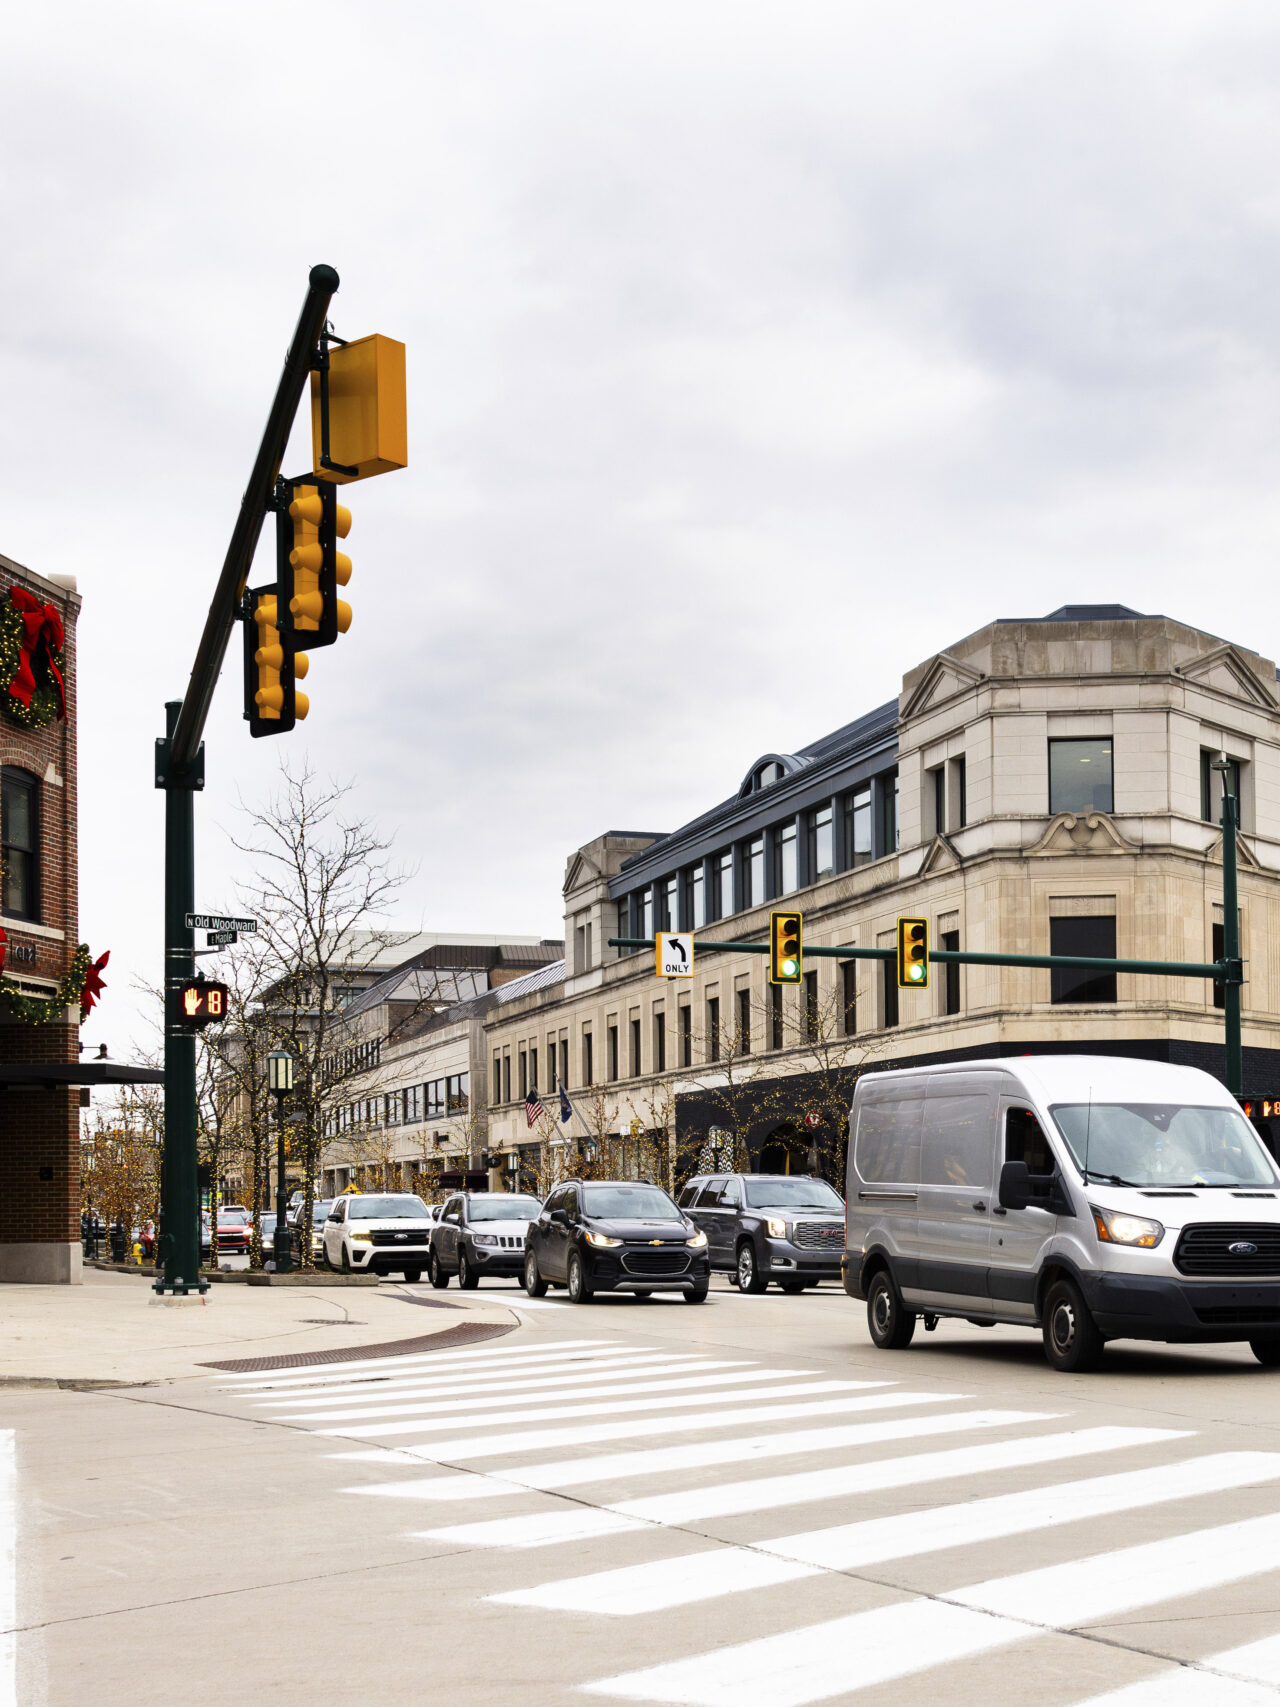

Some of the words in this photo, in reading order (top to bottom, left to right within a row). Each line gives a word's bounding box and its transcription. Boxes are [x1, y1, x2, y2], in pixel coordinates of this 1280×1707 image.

[188, 918, 193, 927] N
[195, 916, 209, 928] Old
[211, 918, 256, 931] Woodward
[215, 932, 233, 943] Maple
[665, 964, 689, 973] ONLY
[208, 991, 221, 1014] 18
